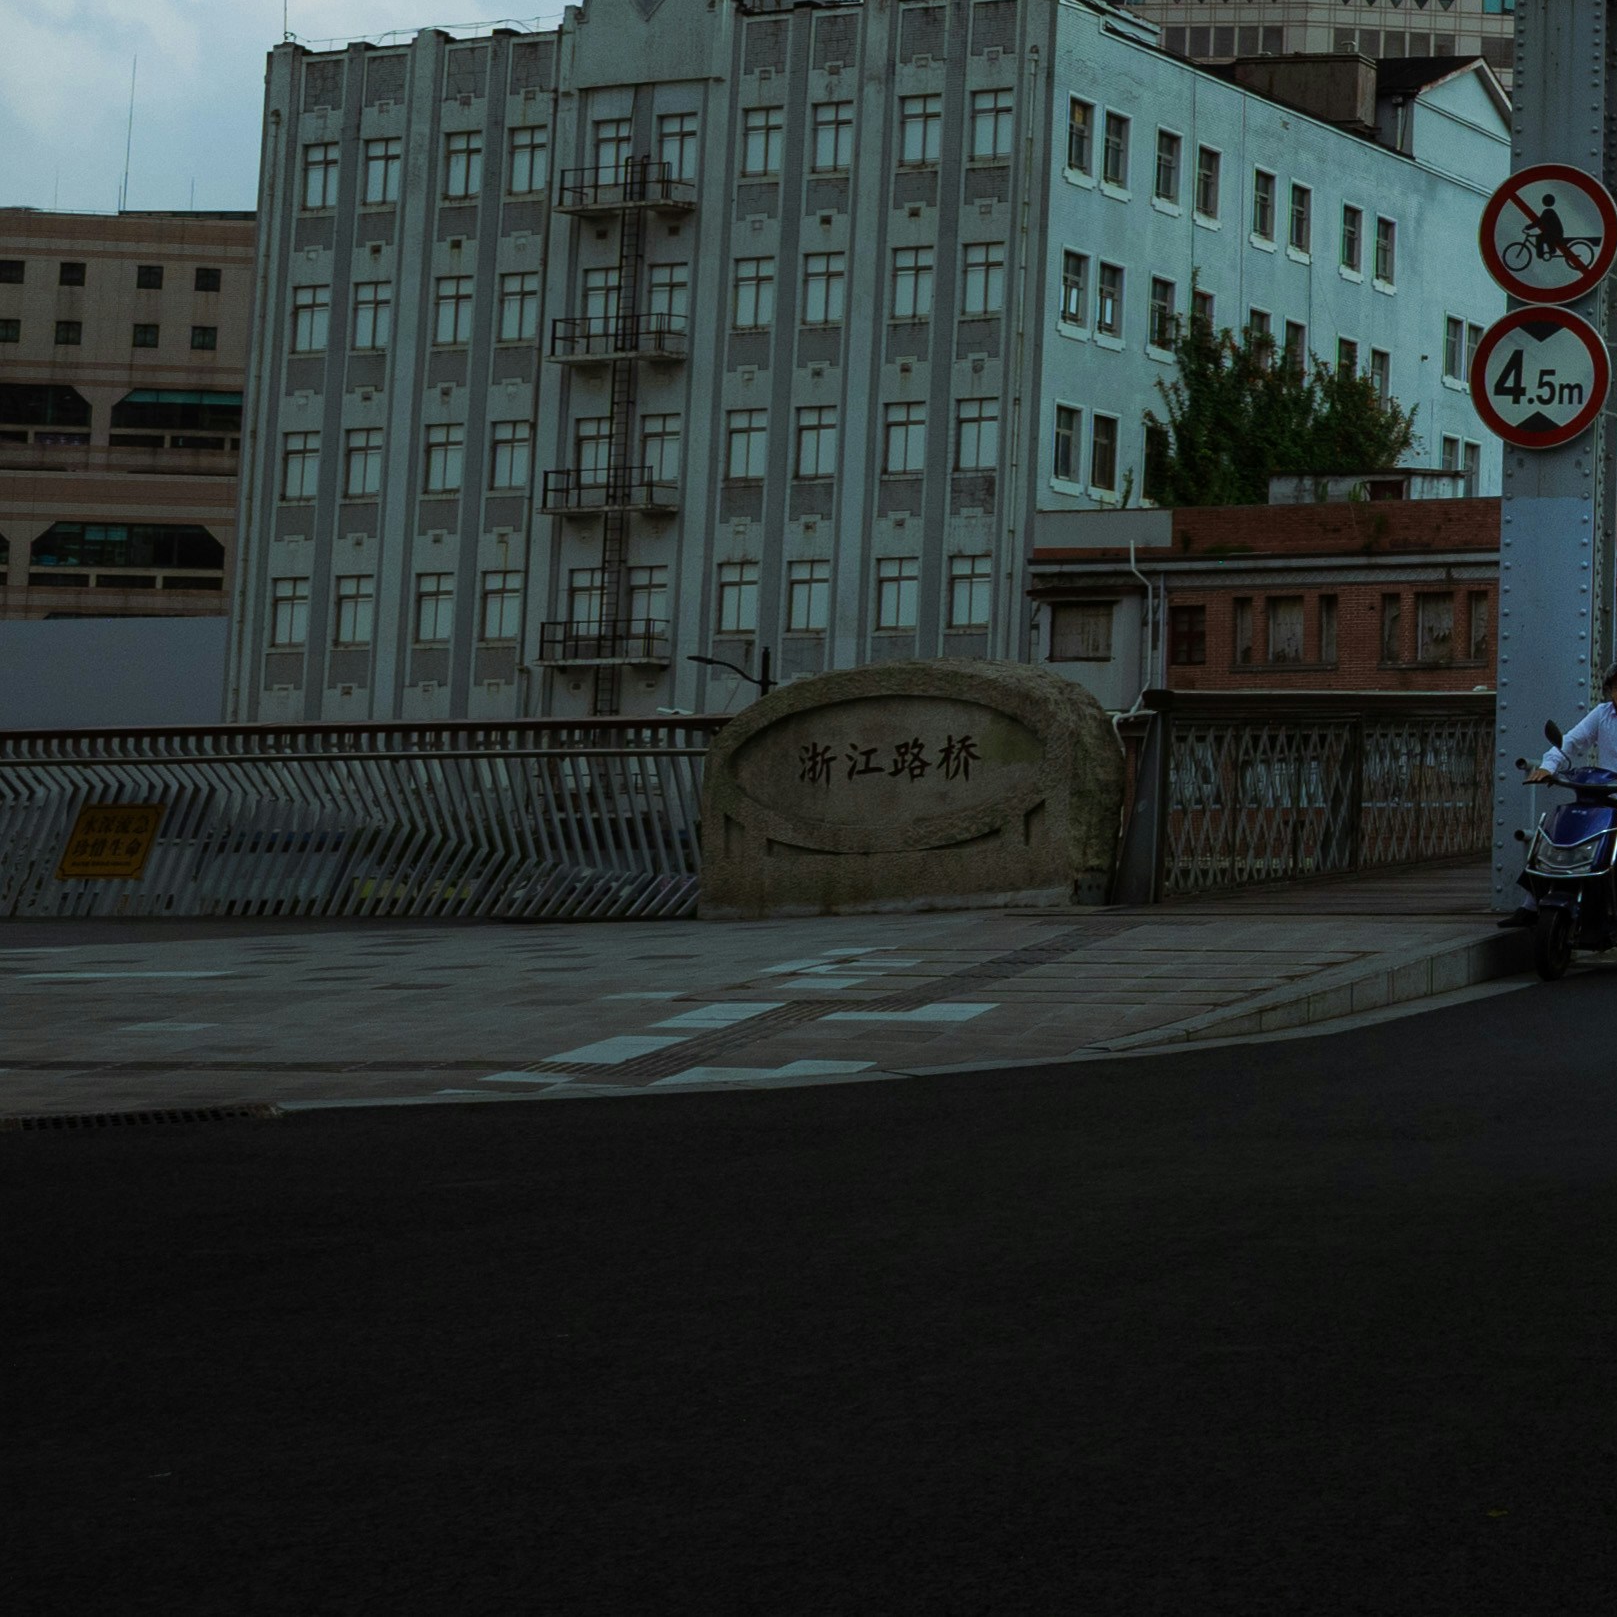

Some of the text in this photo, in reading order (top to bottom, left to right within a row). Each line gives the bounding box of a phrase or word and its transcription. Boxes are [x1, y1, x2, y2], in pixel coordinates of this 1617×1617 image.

[1494, 348, 1584, 406] 4.5m
[797, 734, 983, 788] 浙江路桥
[72, 837, 142, 857] 珍惜生命
